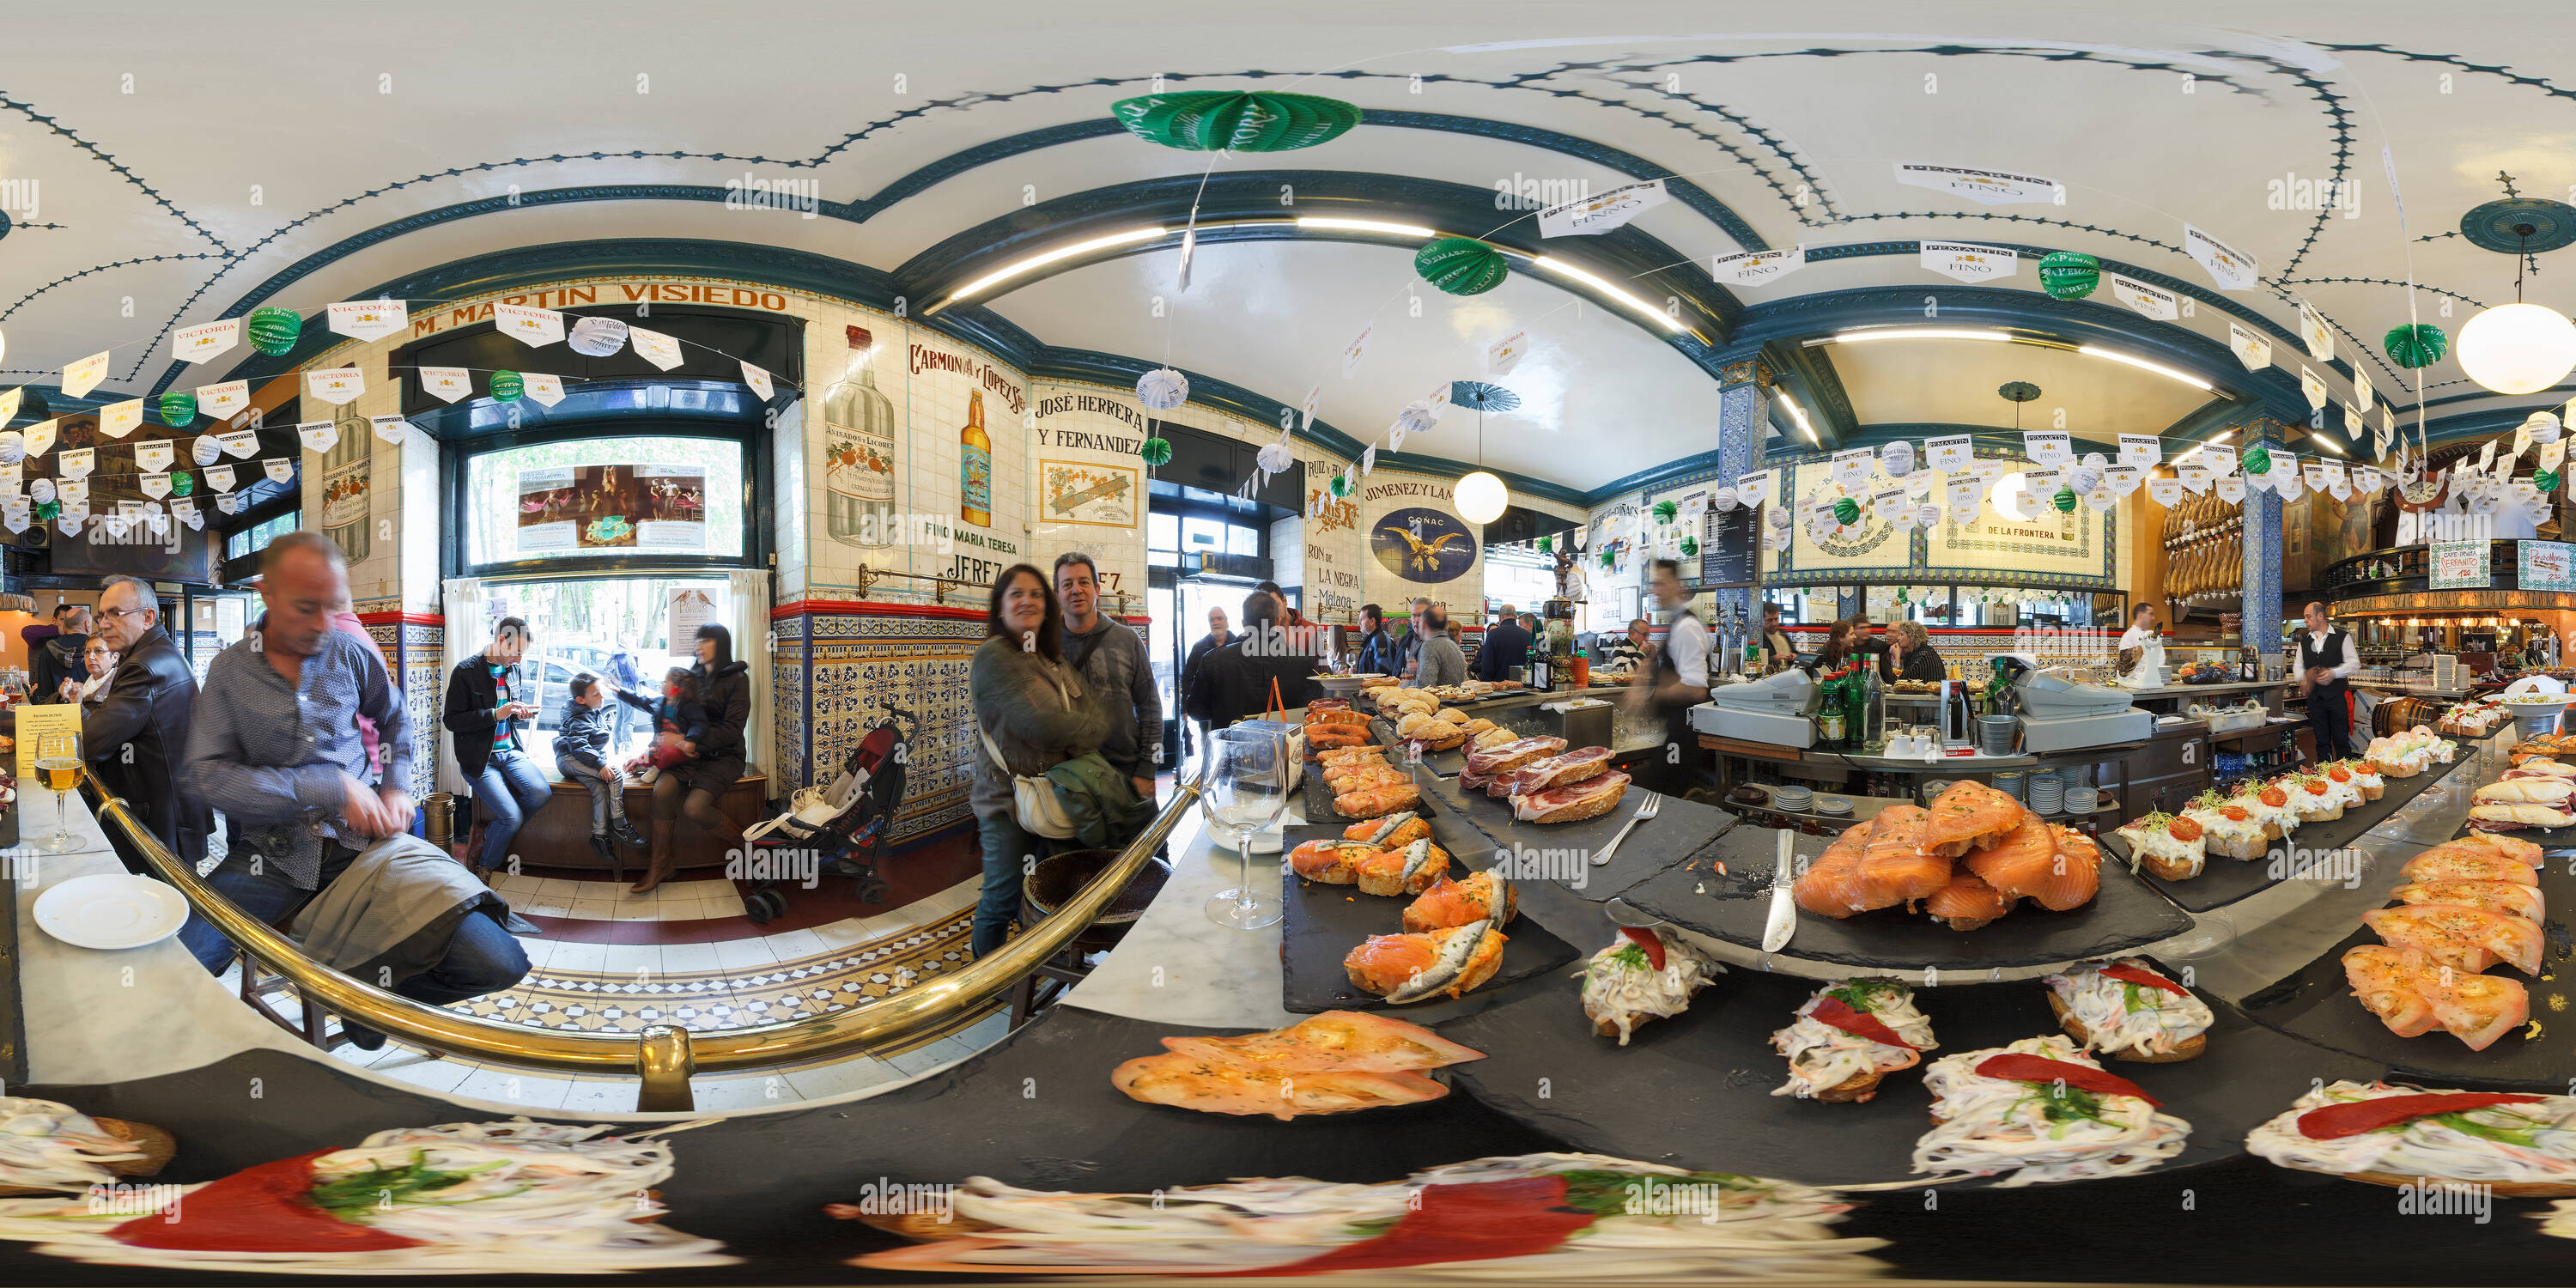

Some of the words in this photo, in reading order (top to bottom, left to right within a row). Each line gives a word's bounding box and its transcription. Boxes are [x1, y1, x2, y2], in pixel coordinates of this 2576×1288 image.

[1950, 180, 2024, 197] FINO
[1925, 245, 2014, 257] PEMARTIN
[1737, 264, 1778, 278] FINO
[1948, 263, 1992, 274] FINO
[331, 303, 403, 313] VICTORIA
[414, 319, 442, 339] M.
[621, 283, 787, 312] VISIEDO
[499, 307, 560, 323] VICTORIA
[178, 322, 235, 341] VICTORIA
[1344, 326, 1372, 356] VICTORIA
[311, 371, 360, 381] VICTORIA
[199, 384, 246, 397] VICTORIA
[1078, 394, 1144, 434] HERRERA
[826, 425, 863, 442] ANISADOS
[866, 436, 895, 449] LICORES
[1038, 428, 1049, 446] Y
[1056, 429, 1143, 457] FERNANDEZ
[1927, 438, 1970, 448] PEMARTIN
[2121, 437, 2159, 446] PEMARTIN
[136, 442, 172, 451] PEMARTIN
[1940, 456, 1961, 465] FINO
[1307, 460, 1326, 479] RUIZ
[1365, 483, 1419, 502] JIMENEZ
[1420, 483, 1429, 496] Y
[1408, 515, 1444, 526] COÑAC
[926, 522, 950, 539] FINO
[954, 529, 985, 548] MARIA
[987, 538, 1017, 556] TERESA
[1988, 526, 1999, 535] DE
[2001, 527, 2012, 536] LA
[2014, 528, 2055, 539] FRONTERA
[1309, 544, 1324, 562] RON
[1325, 553, 1334, 563] DE
[2440, 557, 2478, 576] SERRANITO
[1319, 567, 1332, 585] LA
[1334, 570, 1359, 590] NEGRA
